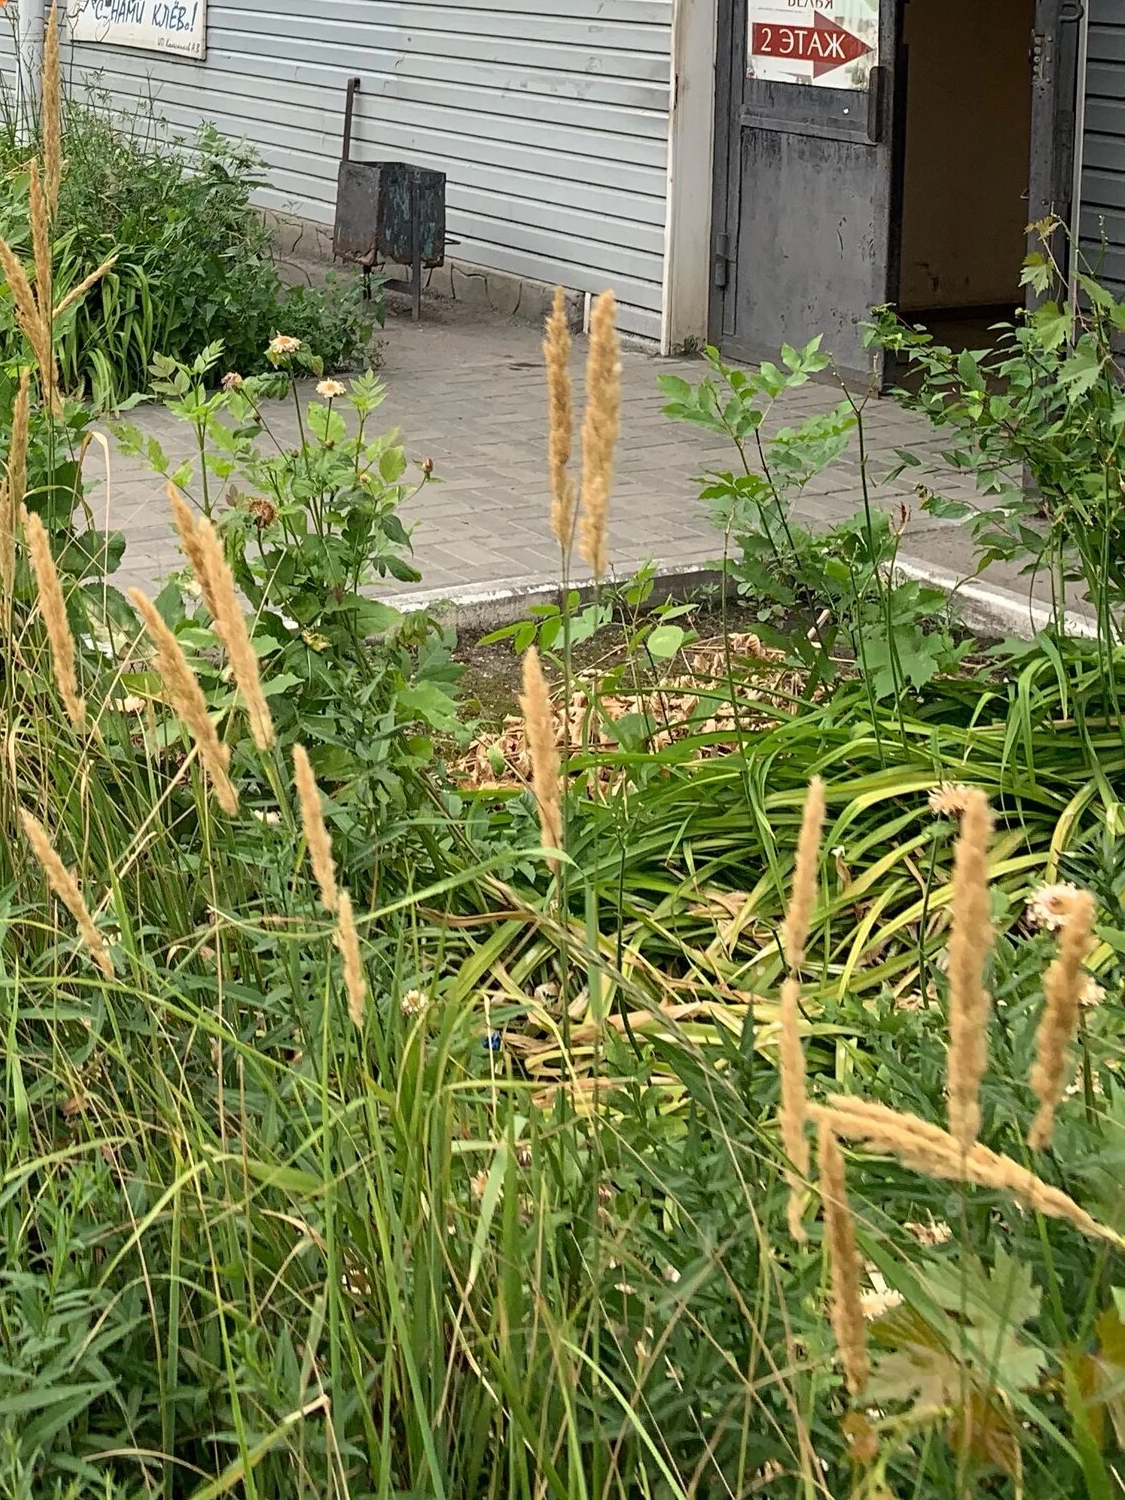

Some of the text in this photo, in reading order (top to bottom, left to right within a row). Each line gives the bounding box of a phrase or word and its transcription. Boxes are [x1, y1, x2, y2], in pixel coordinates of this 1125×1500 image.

[110, 0, 146, 24] НАМИ
[760, 27, 846, 59] 2 ЭТАЖ
